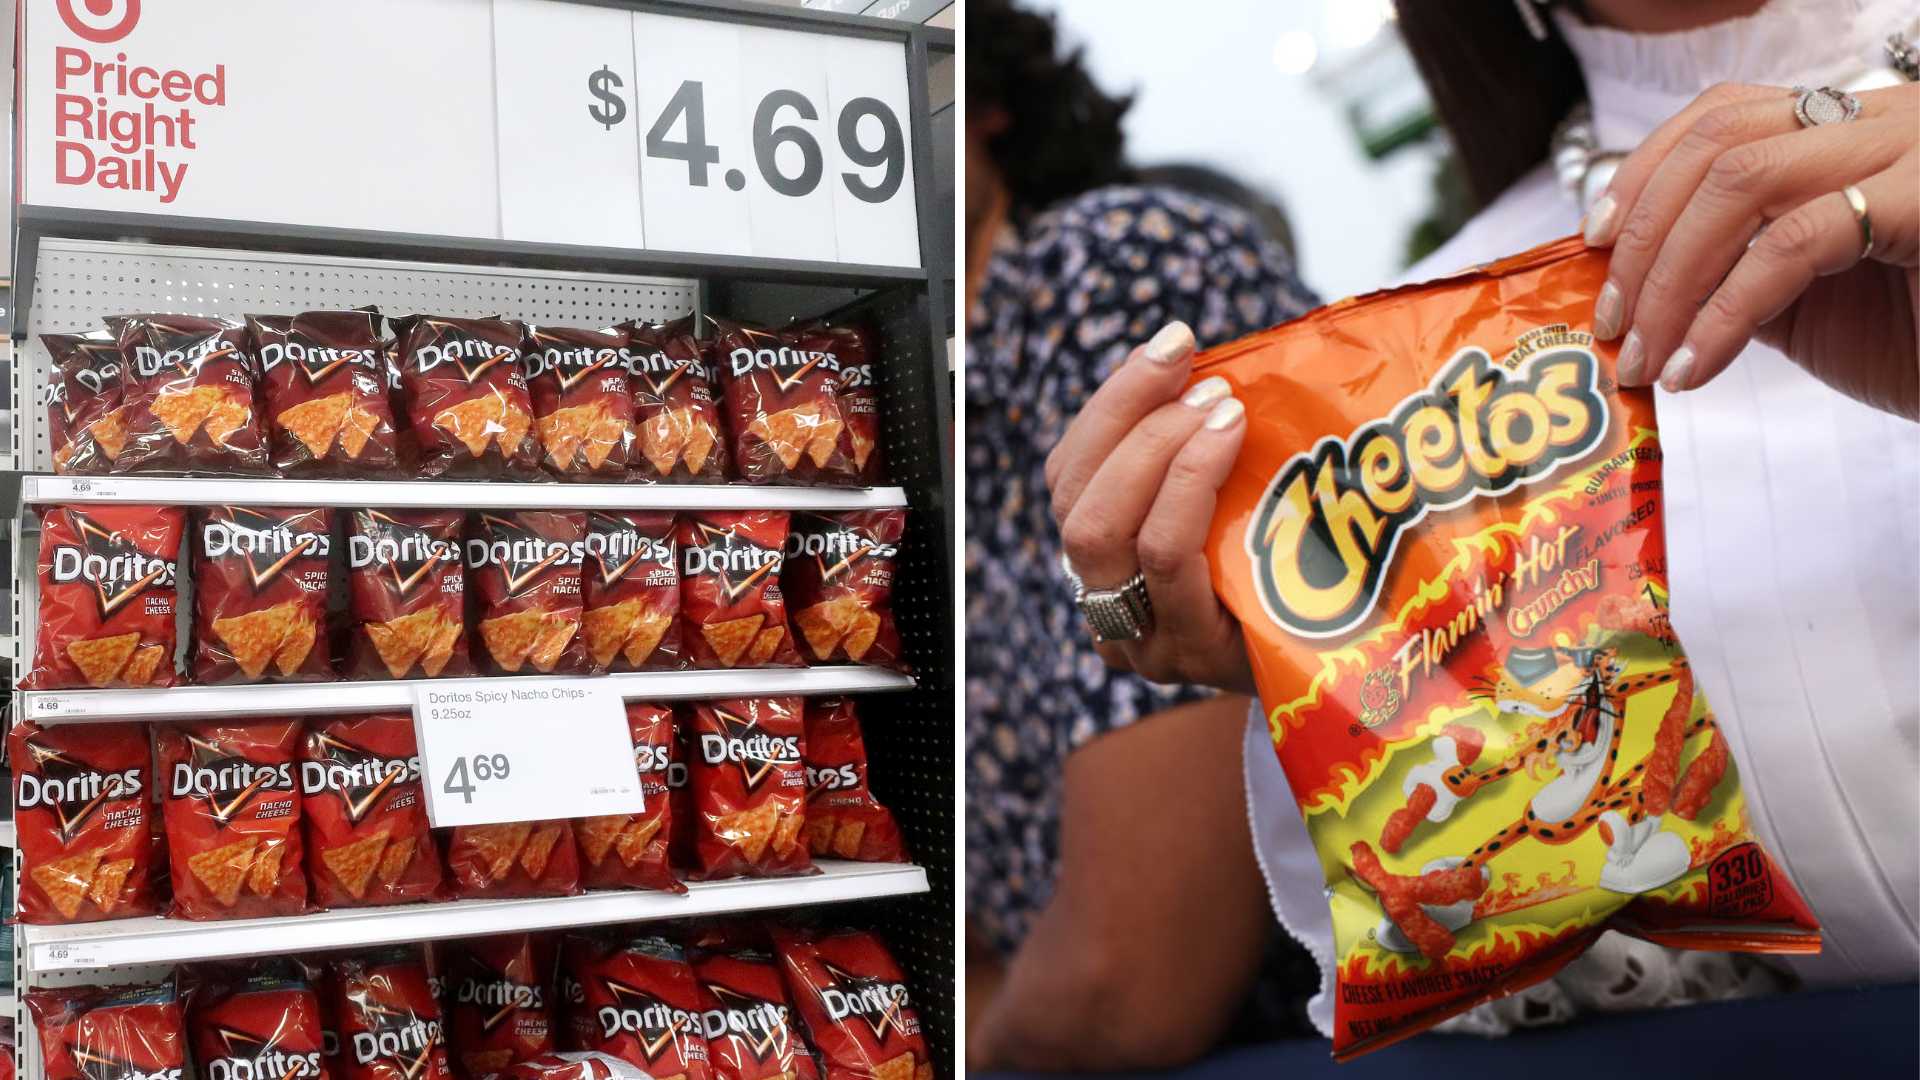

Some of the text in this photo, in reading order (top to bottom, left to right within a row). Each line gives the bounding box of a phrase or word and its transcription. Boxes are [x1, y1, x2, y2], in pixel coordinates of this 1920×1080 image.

[56, 46, 226, 106] Priced
[56, 94, 196, 154] Right
[56, 141, 188, 203] Daily
[261, 342, 376, 373] Doritos
[524, 348, 631, 380] Doritos
[628, 350, 705, 378] oritos
[1504, 332, 1593, 371] REAL CHEESE!
[72, 484, 91, 492] 4.69
[1256, 352, 1600, 630] Cheetos
[204, 524, 330, 556] Doritos
[584, 529, 670, 559] oritos
[788, 530, 897, 560] Doritos
[1575, 501, 1656, 564] FLAVORED
[55, 547, 176, 585] Doritos
[350, 533, 461, 568] Doritos
[467, 538, 585, 569] Doritos
[685, 546, 784, 576] Dorito
[1512, 525, 1580, 592] Hot
[552, 586, 581, 594] NACH
[558, 577, 581, 585] SPIC
[645, 577, 677, 586] NACHO
[1507, 560, 1599, 637] Crunchy
[38, 702, 58, 710] 4.69
[429, 692, 472, 704] Doritos
[475, 690, 508, 704] Spicy
[512, 689, 549, 701] Nacho
[552, 688, 585, 702] Chips
[431, 709, 472, 720] 9.25oz
[702, 734, 800, 764] Doritos
[19, 769, 143, 807] Doritos
[173, 762, 293, 796] Doritos
[302, 756, 421, 794] Doritos
[107, 808, 142, 821] NACHO
[255, 808, 291, 820] CHEESE
[260, 800, 292, 811] NACHO
[104, 816, 142, 830] CHEESE
[1715, 848, 1762, 892] 330
[49, 951, 69, 959] 4.69
[459, 979, 543, 1008] Doritos
[822, 984, 909, 1020] Dorito
[1342, 982, 1382, 1005] CHEESE
[1386, 973, 1451, 1000] FLAVORED
[599, 1003, 703, 1039] Doritos
[209, 1051, 321, 1080] Doritos
